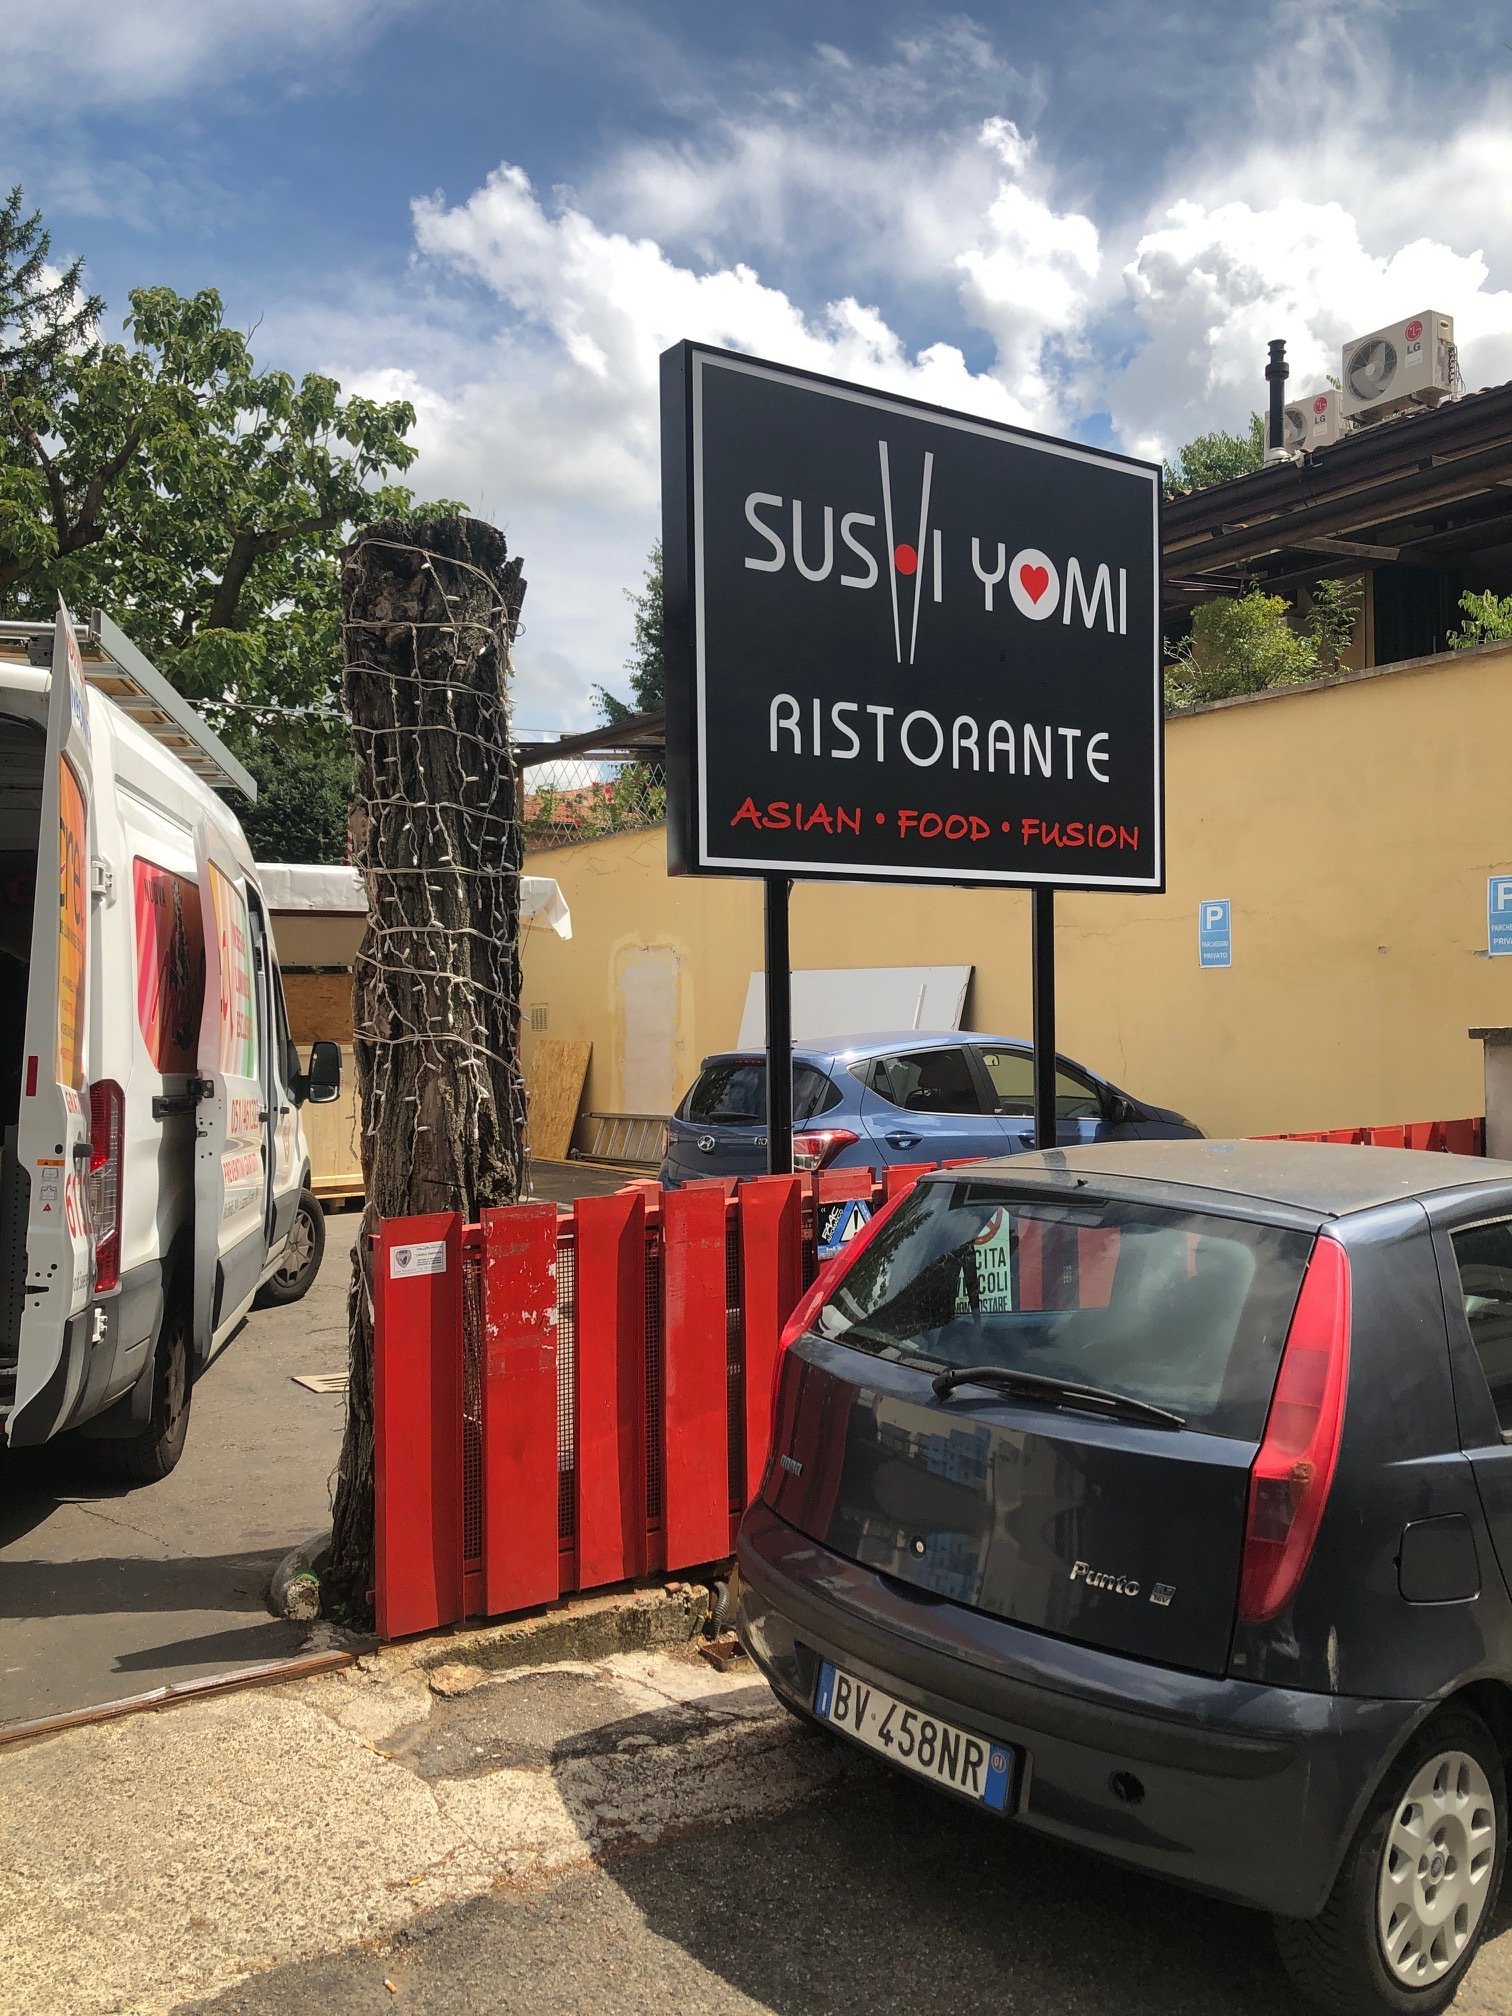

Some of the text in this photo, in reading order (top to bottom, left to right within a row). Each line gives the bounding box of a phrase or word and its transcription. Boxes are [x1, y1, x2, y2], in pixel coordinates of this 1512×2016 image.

[1407, 342, 1421, 354] LG
[1314, 415, 1326, 425] LG
[744, 440, 1127, 664] SUSHI YOMI
[769, 694, 1110, 783] RISTORANTE
[730, 797, 1139, 850] ASIAN FOOD FUSION
[1497, 883, 1512, 910] P
[1206, 906, 1223, 929] P
[821, 1206, 839, 1240] FAAC
[975, 1247, 1006, 1271] CITA
[977, 1271, 1008, 1295] COLI
[1070, 1561, 1140, 1596] Punto
[878, 1703, 984, 1793] 458NR
